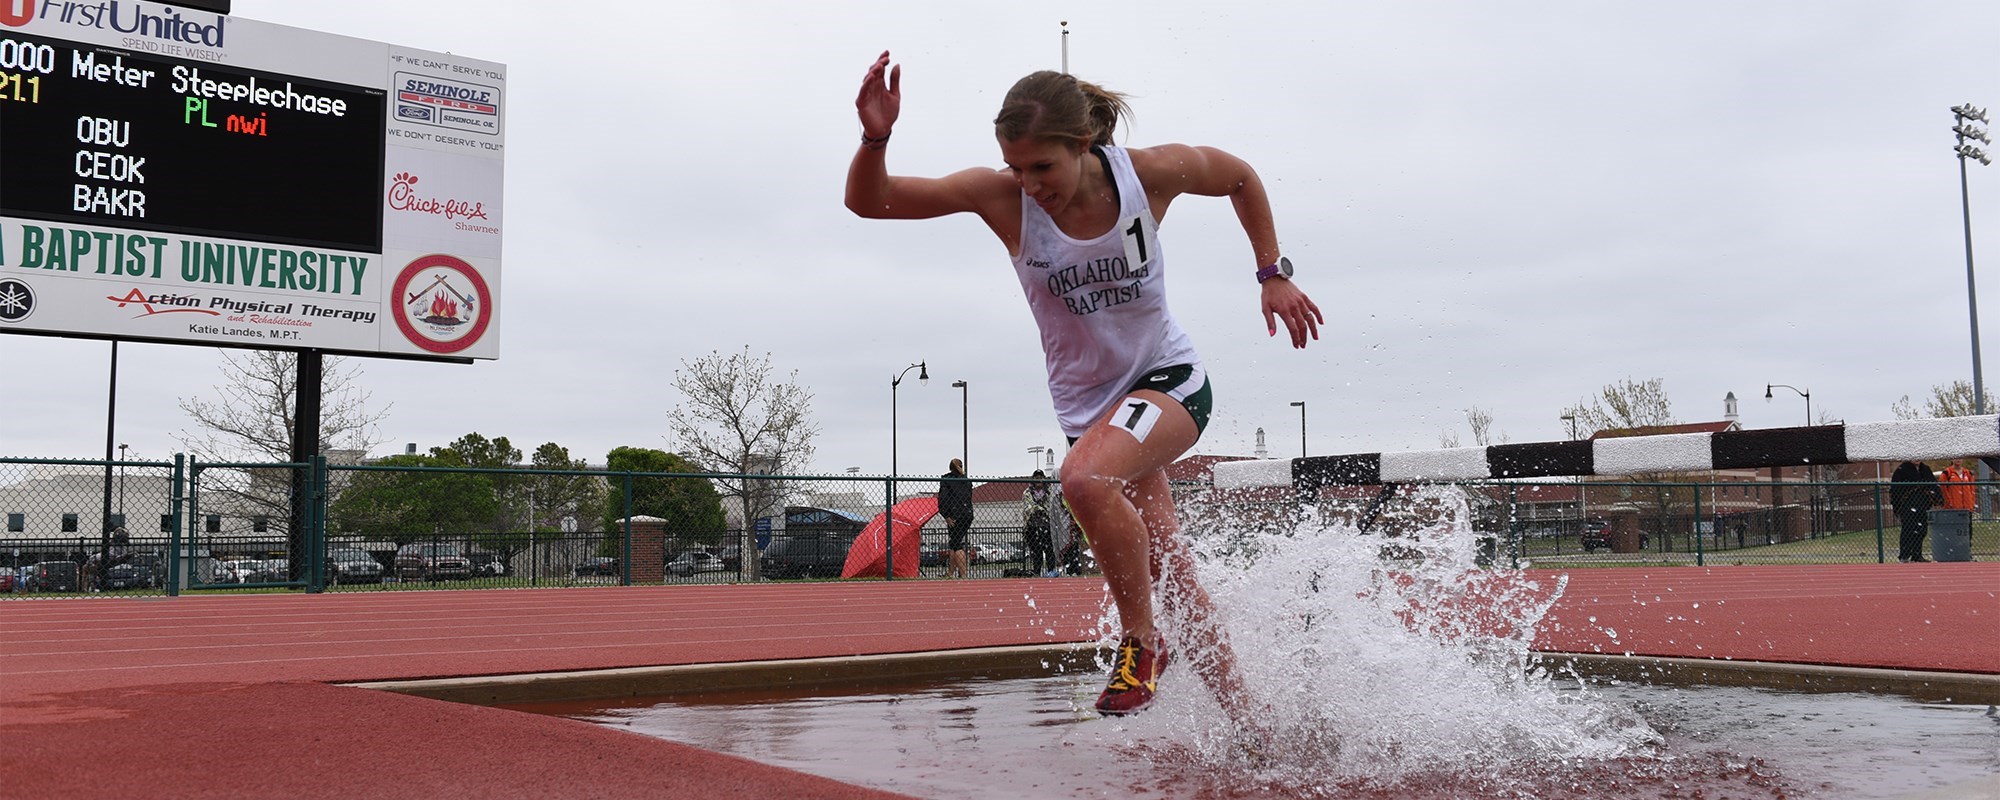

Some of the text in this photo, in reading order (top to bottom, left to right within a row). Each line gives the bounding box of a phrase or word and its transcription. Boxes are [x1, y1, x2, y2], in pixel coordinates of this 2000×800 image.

[122, 37, 224, 62] SPEND LIFE WISELY
[72, 50, 155, 88] Meter
[171, 65, 347, 116] Steeplechase
[406, 57, 420, 65] WE
[422, 60, 449, 70] CAN'T
[453, 65, 481, 76] SERVE
[484, 71, 504, 80] YOU,
[406, 80, 490, 102] SEMINOLE
[76, 115, 130, 148] OBU
[185, 96, 267, 137] PL nwi
[388, 128, 402, 137] WE
[404, 130, 432, 141] DON'T
[435, 135, 476, 148] DESERVE
[73, 183, 146, 218] BAKR
[388, 181, 488, 221] Chick-fil-A
[455, 222, 499, 234] Shawnee
[1126, 217, 1147, 264] 1
[19, 224, 168, 279] BAPTIST
[179, 239, 369, 296] UNIVERSITY
[107, 287, 377, 324] Action Physical Therapy
[1062, 279, 1143, 316] BAPTIST
[189, 324, 302, 341] Katie Landes, M.P.T.
[227, 314, 313, 328] and Rehabilitation
[1125, 402, 1149, 431] 1
